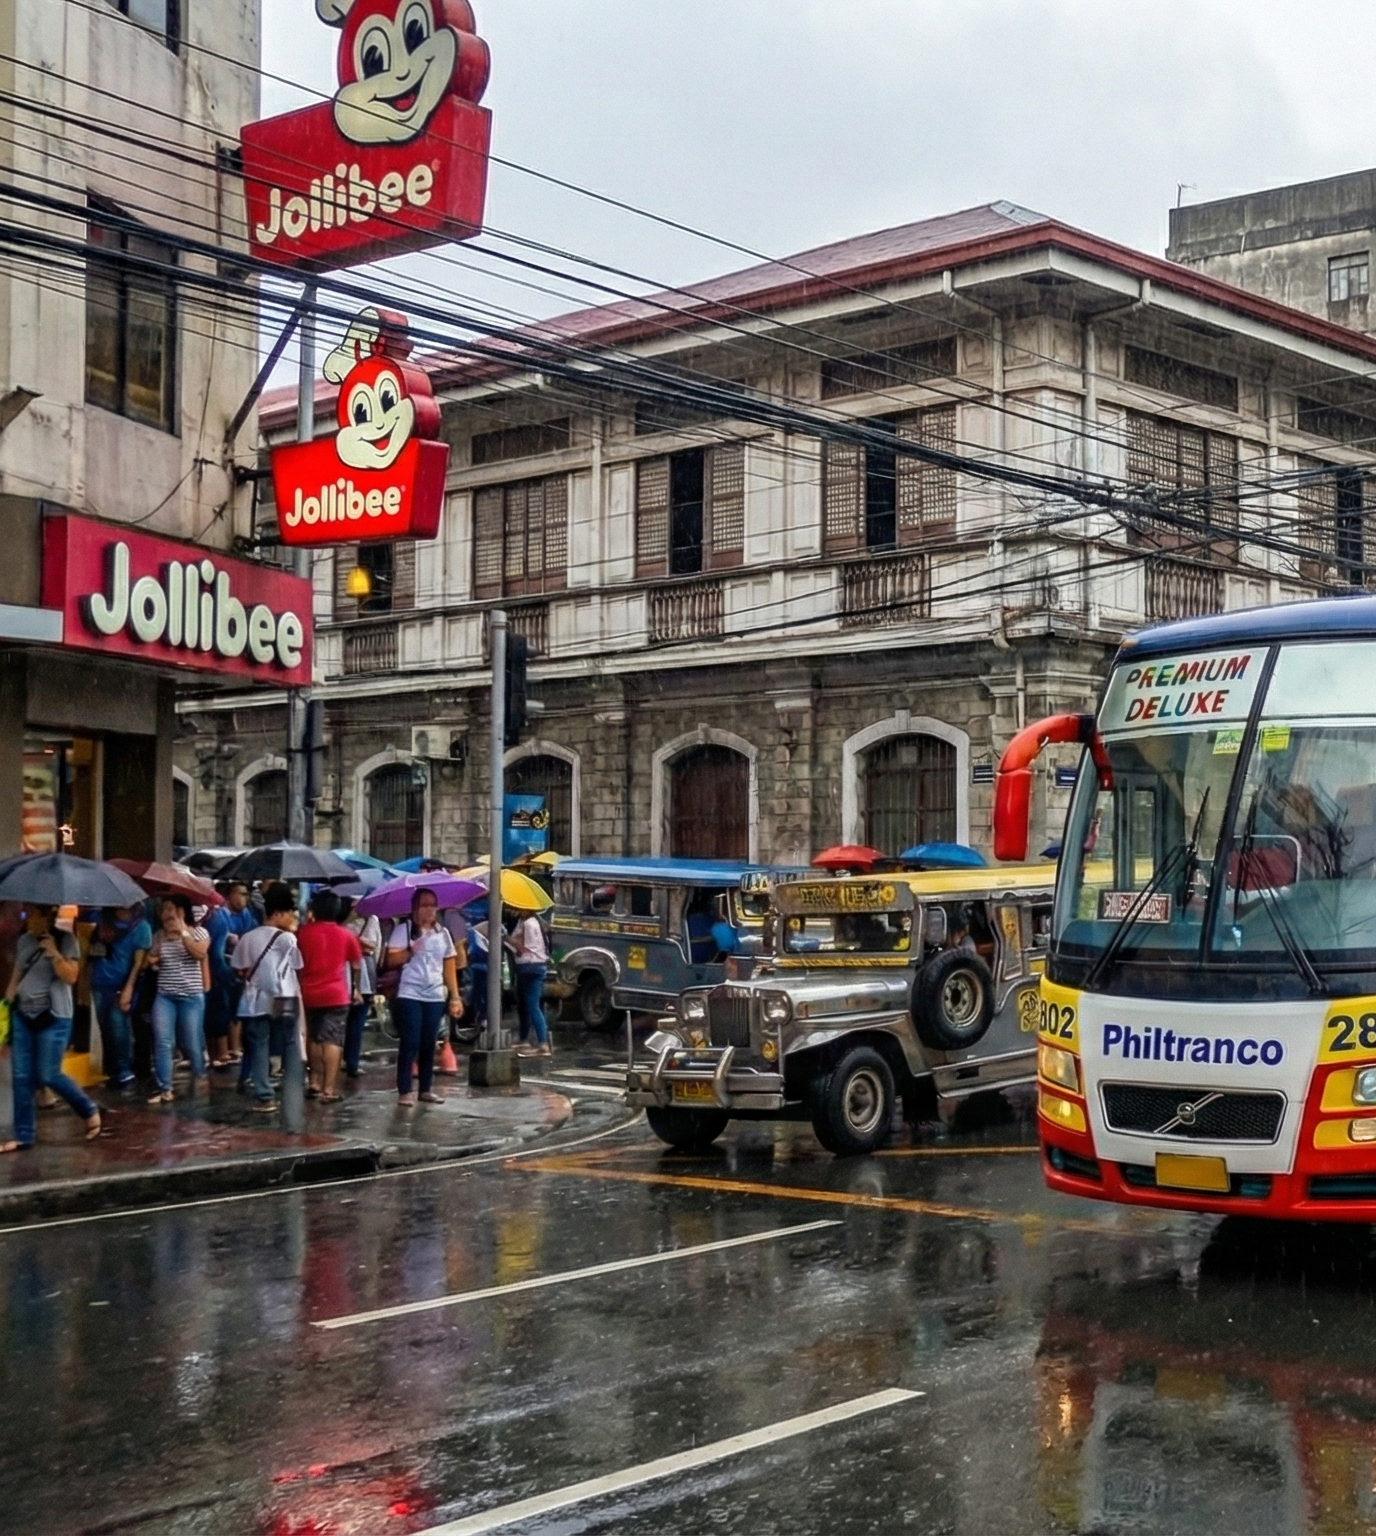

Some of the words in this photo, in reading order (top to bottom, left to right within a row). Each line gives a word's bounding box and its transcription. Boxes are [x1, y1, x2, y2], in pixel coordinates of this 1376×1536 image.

[256, 163, 433, 243] Jollibee
[285, 477, 402, 527] Jollibee
[91, 541, 304, 668] Jollibee
[1126, 654, 1252, 689] PREMIUM
[1125, 689, 1230, 722] DELUXE
[1102, 1024, 1284, 1066] Philtranco
